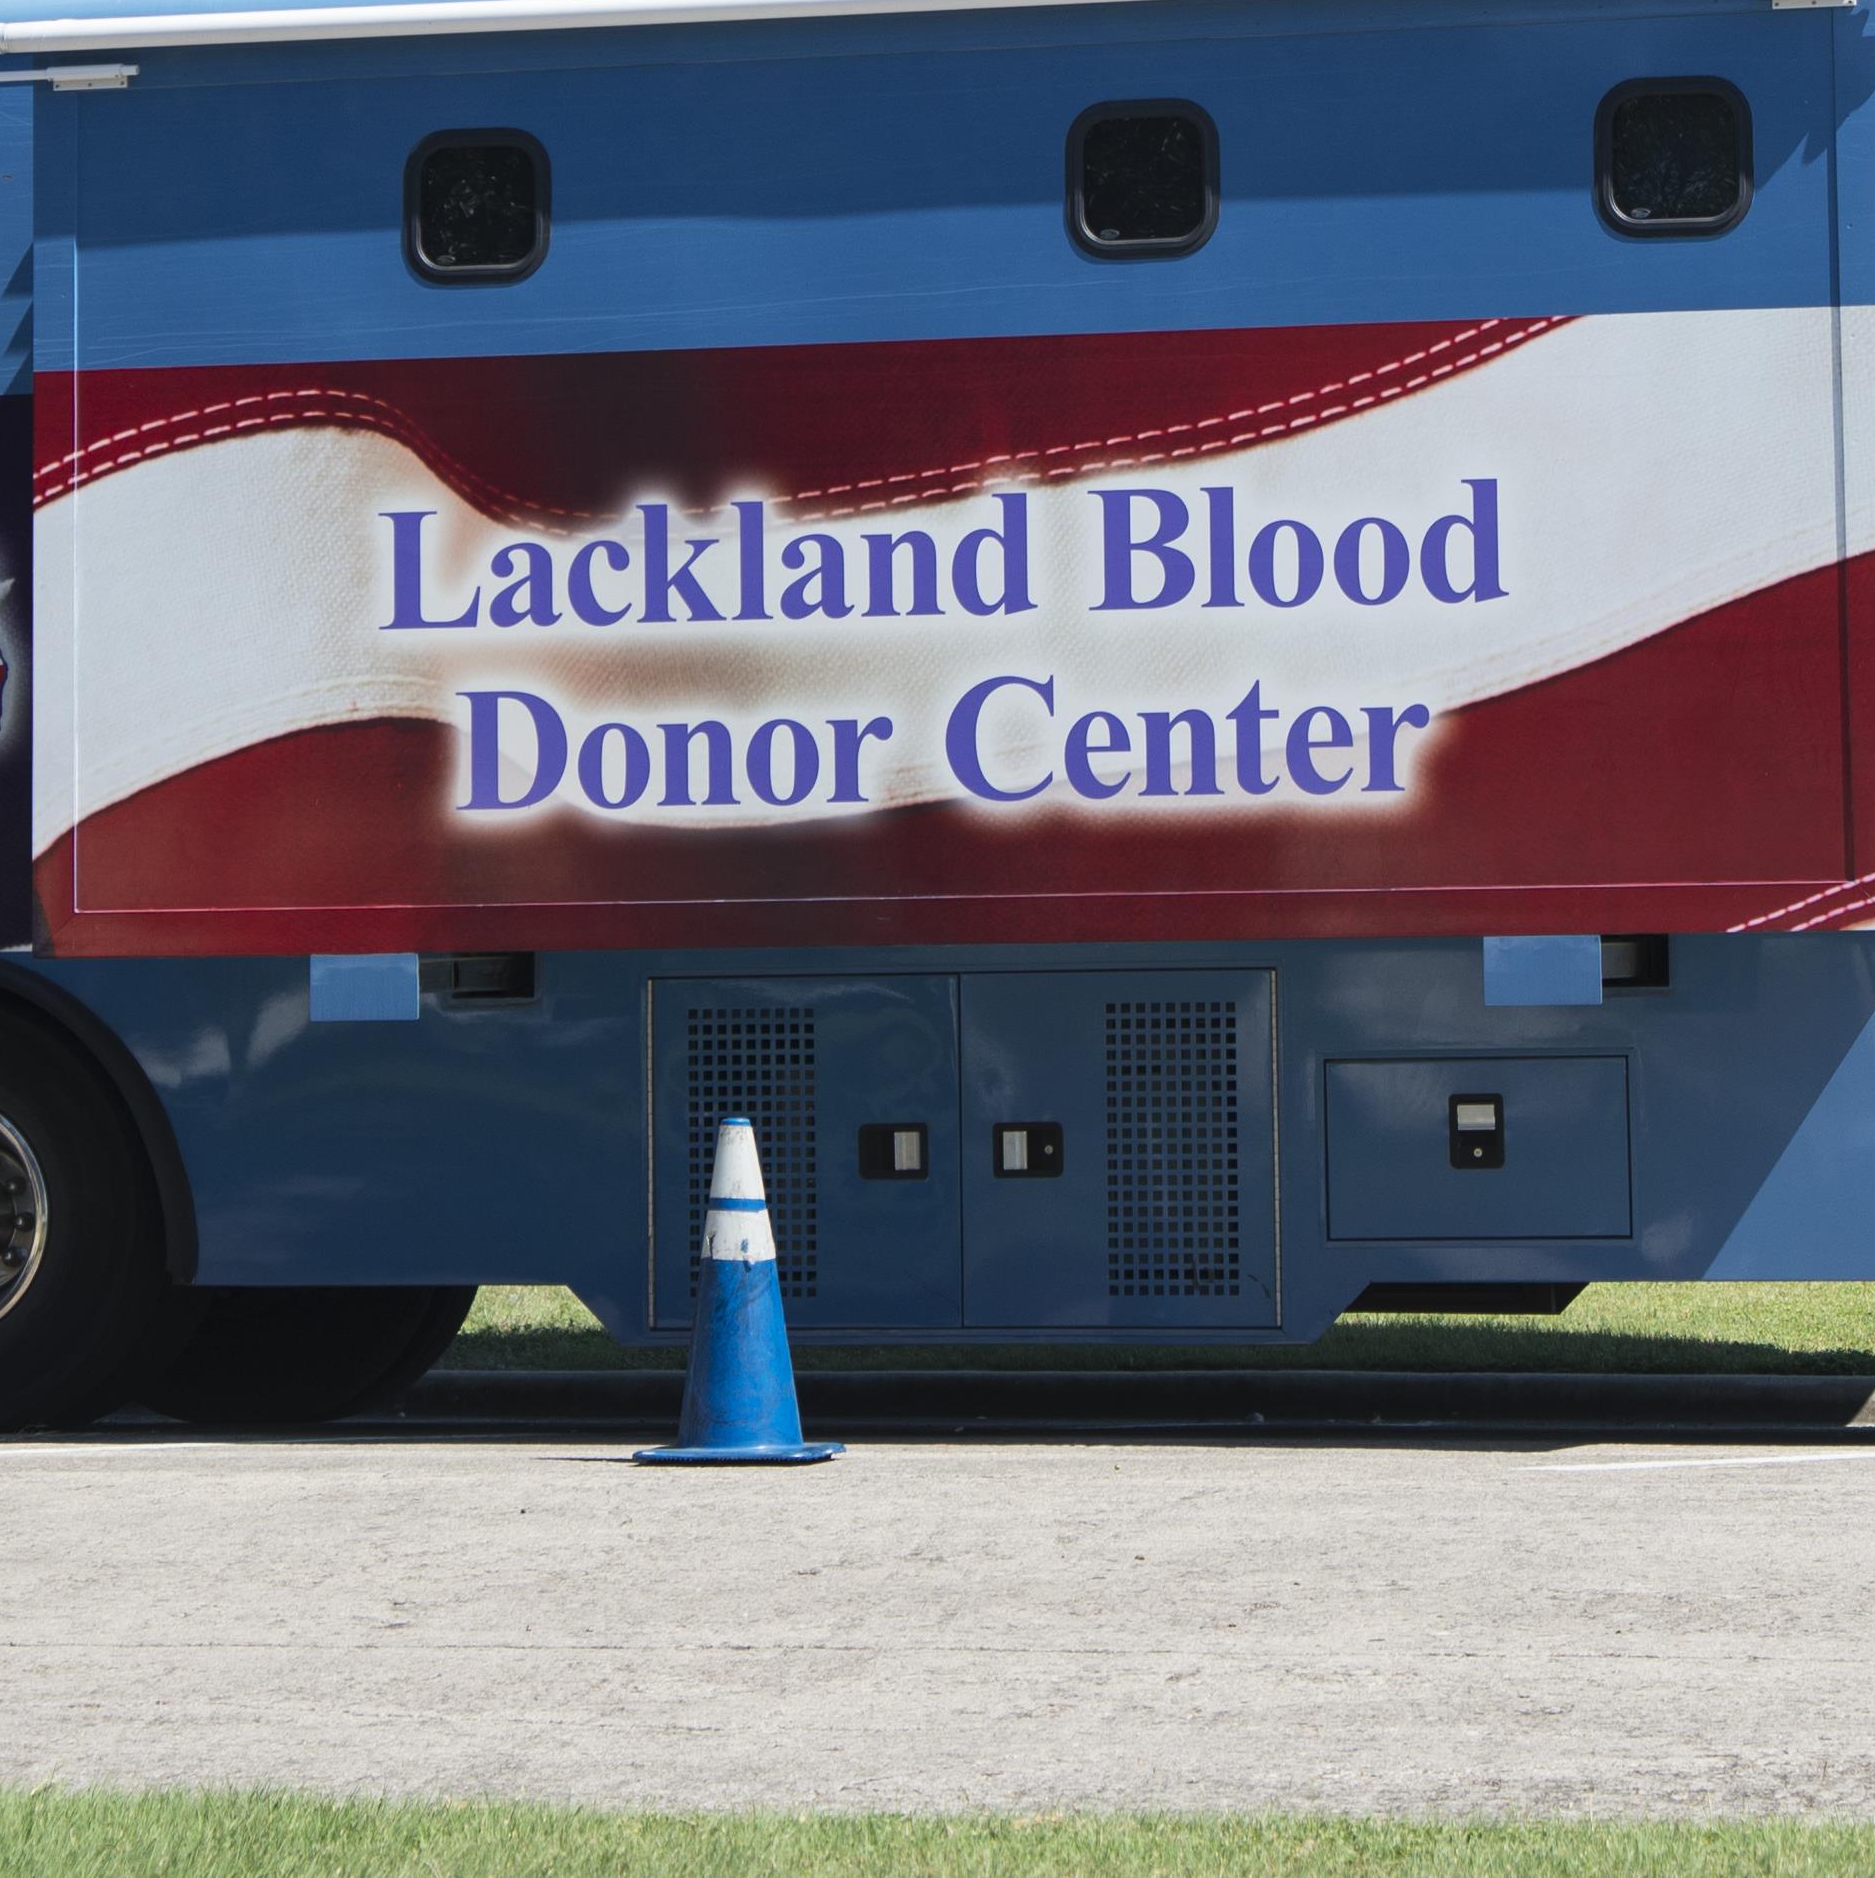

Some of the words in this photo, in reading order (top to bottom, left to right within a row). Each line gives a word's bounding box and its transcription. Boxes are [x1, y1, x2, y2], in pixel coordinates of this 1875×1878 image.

[379, 492, 1037, 631] Lackland
[1088, 478, 1510, 611] Blood
[456, 689, 893, 812] Donor
[946, 675, 1430, 803] Center
